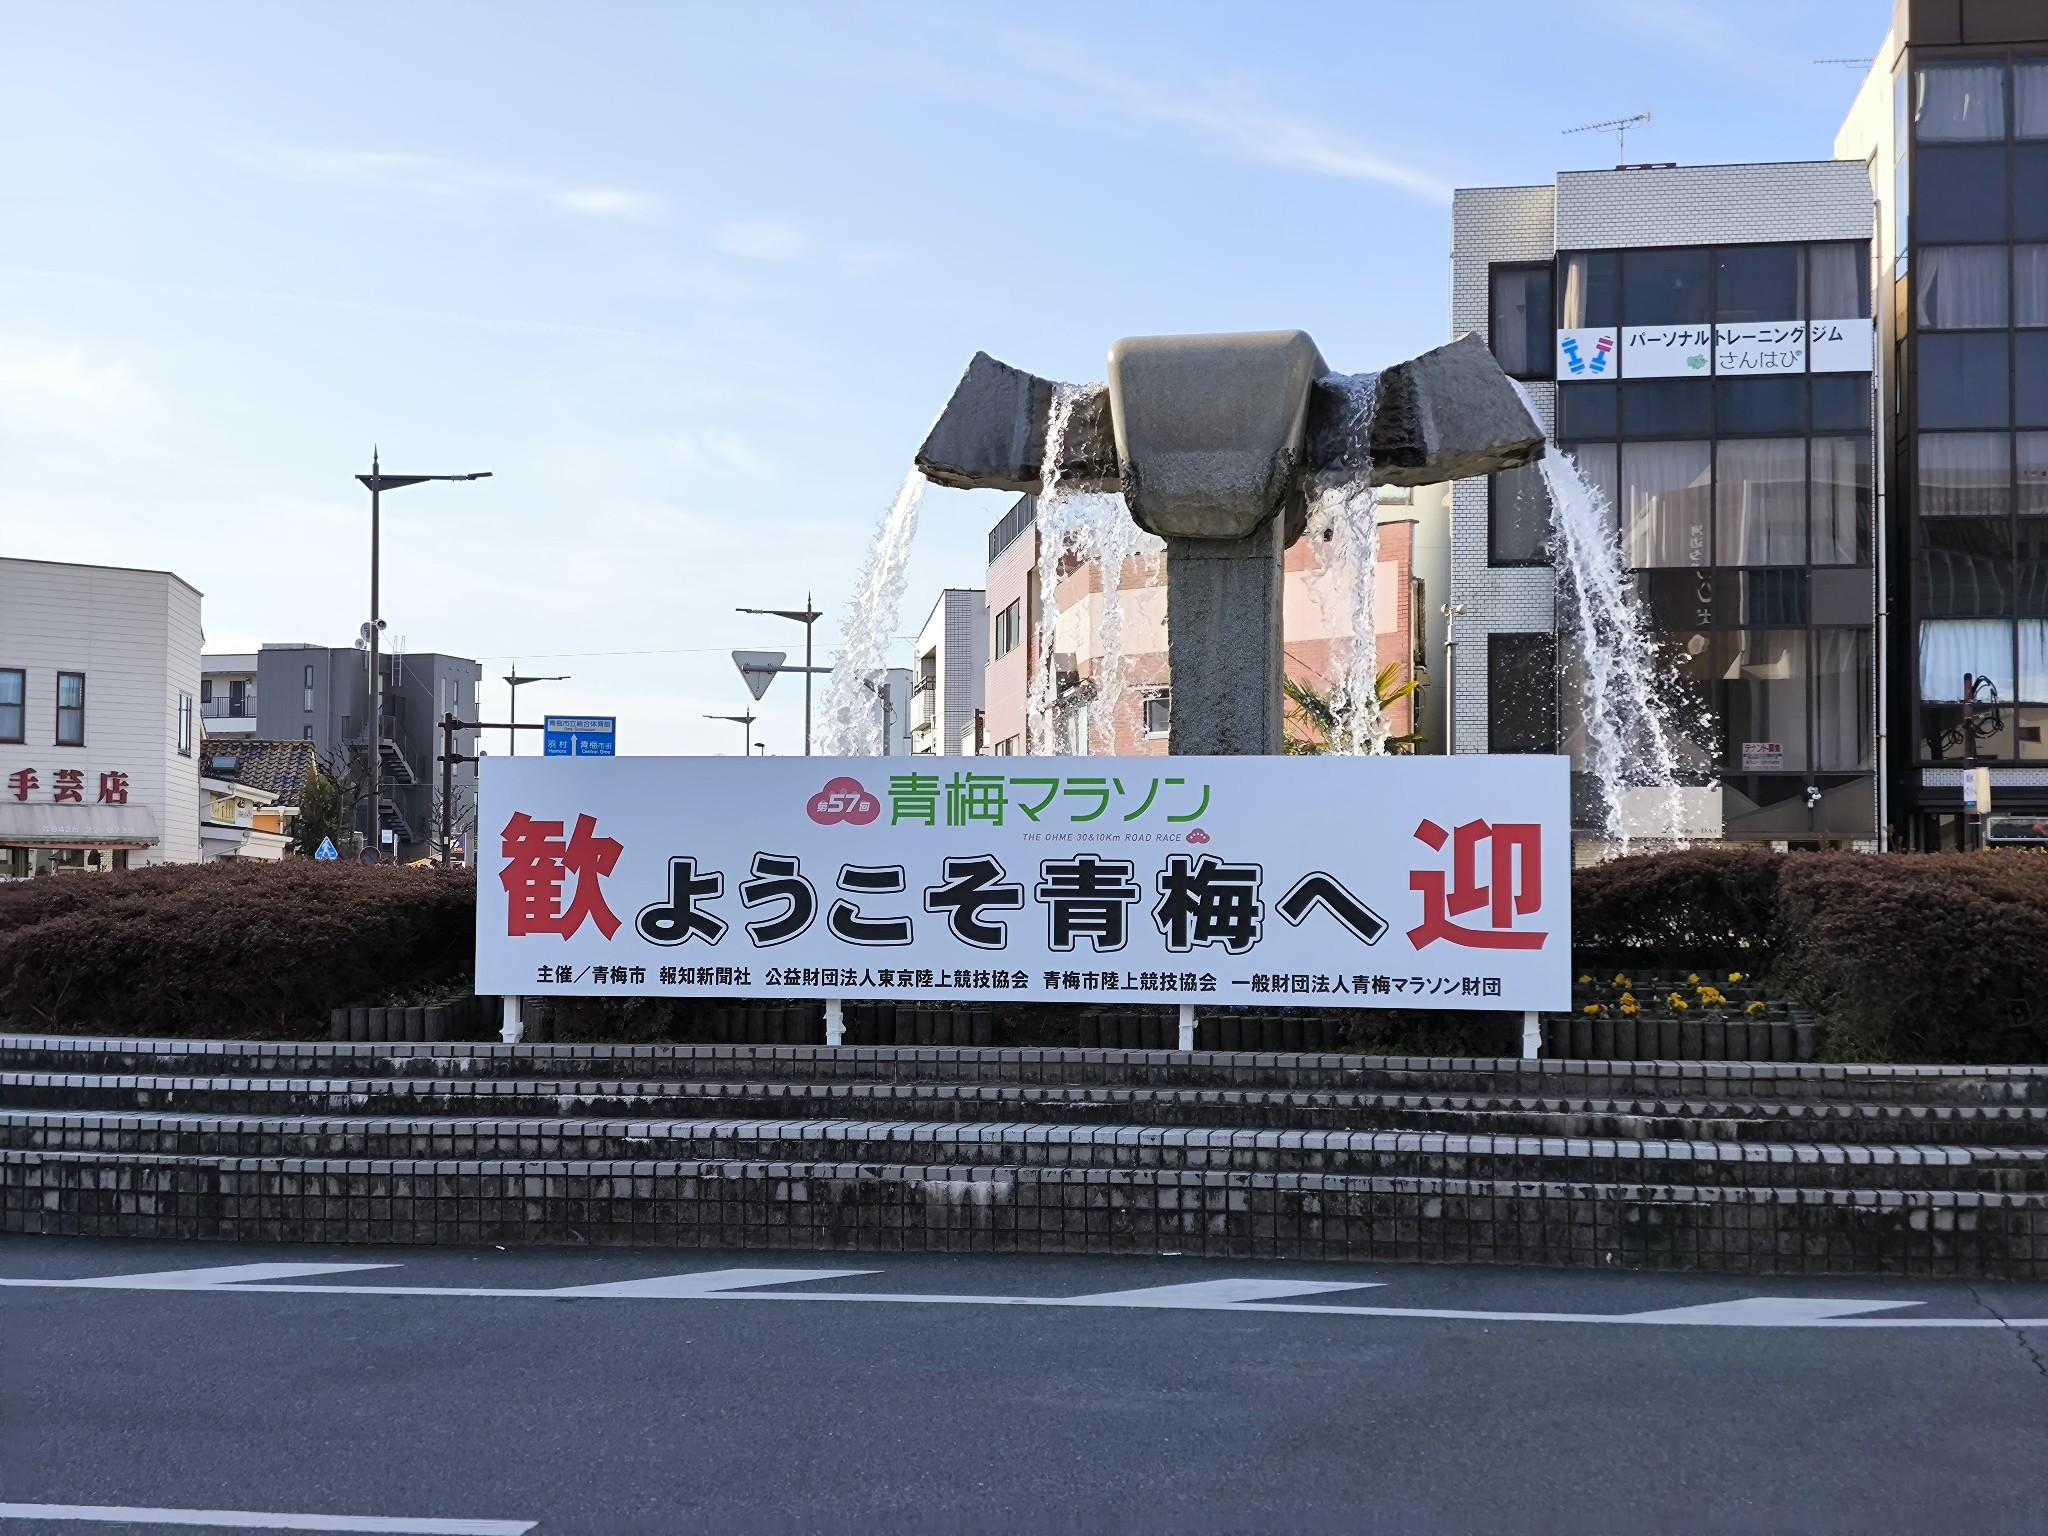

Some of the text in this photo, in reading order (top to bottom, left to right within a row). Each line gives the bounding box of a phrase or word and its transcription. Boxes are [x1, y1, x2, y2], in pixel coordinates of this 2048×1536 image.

[1629, 326, 1843, 347] パーソナルトレーニングジム
[8, 767, 130, 804] 手芸店
[816, 771, 1211, 827] 第57回 青梅マラソン
[1023, 833, 1182, 843] THE OHME 30&10Km ROAD RACE
[499, 811, 1550, 956] 歓 ようこそ青梅へ 迎
[537, 965, 1502, 997] 主催／青梅市 報知新聞社 公益財団法人東京陸上競技協会 青梅市陸上競技協会 一般財団法人青梅マラソン財団
